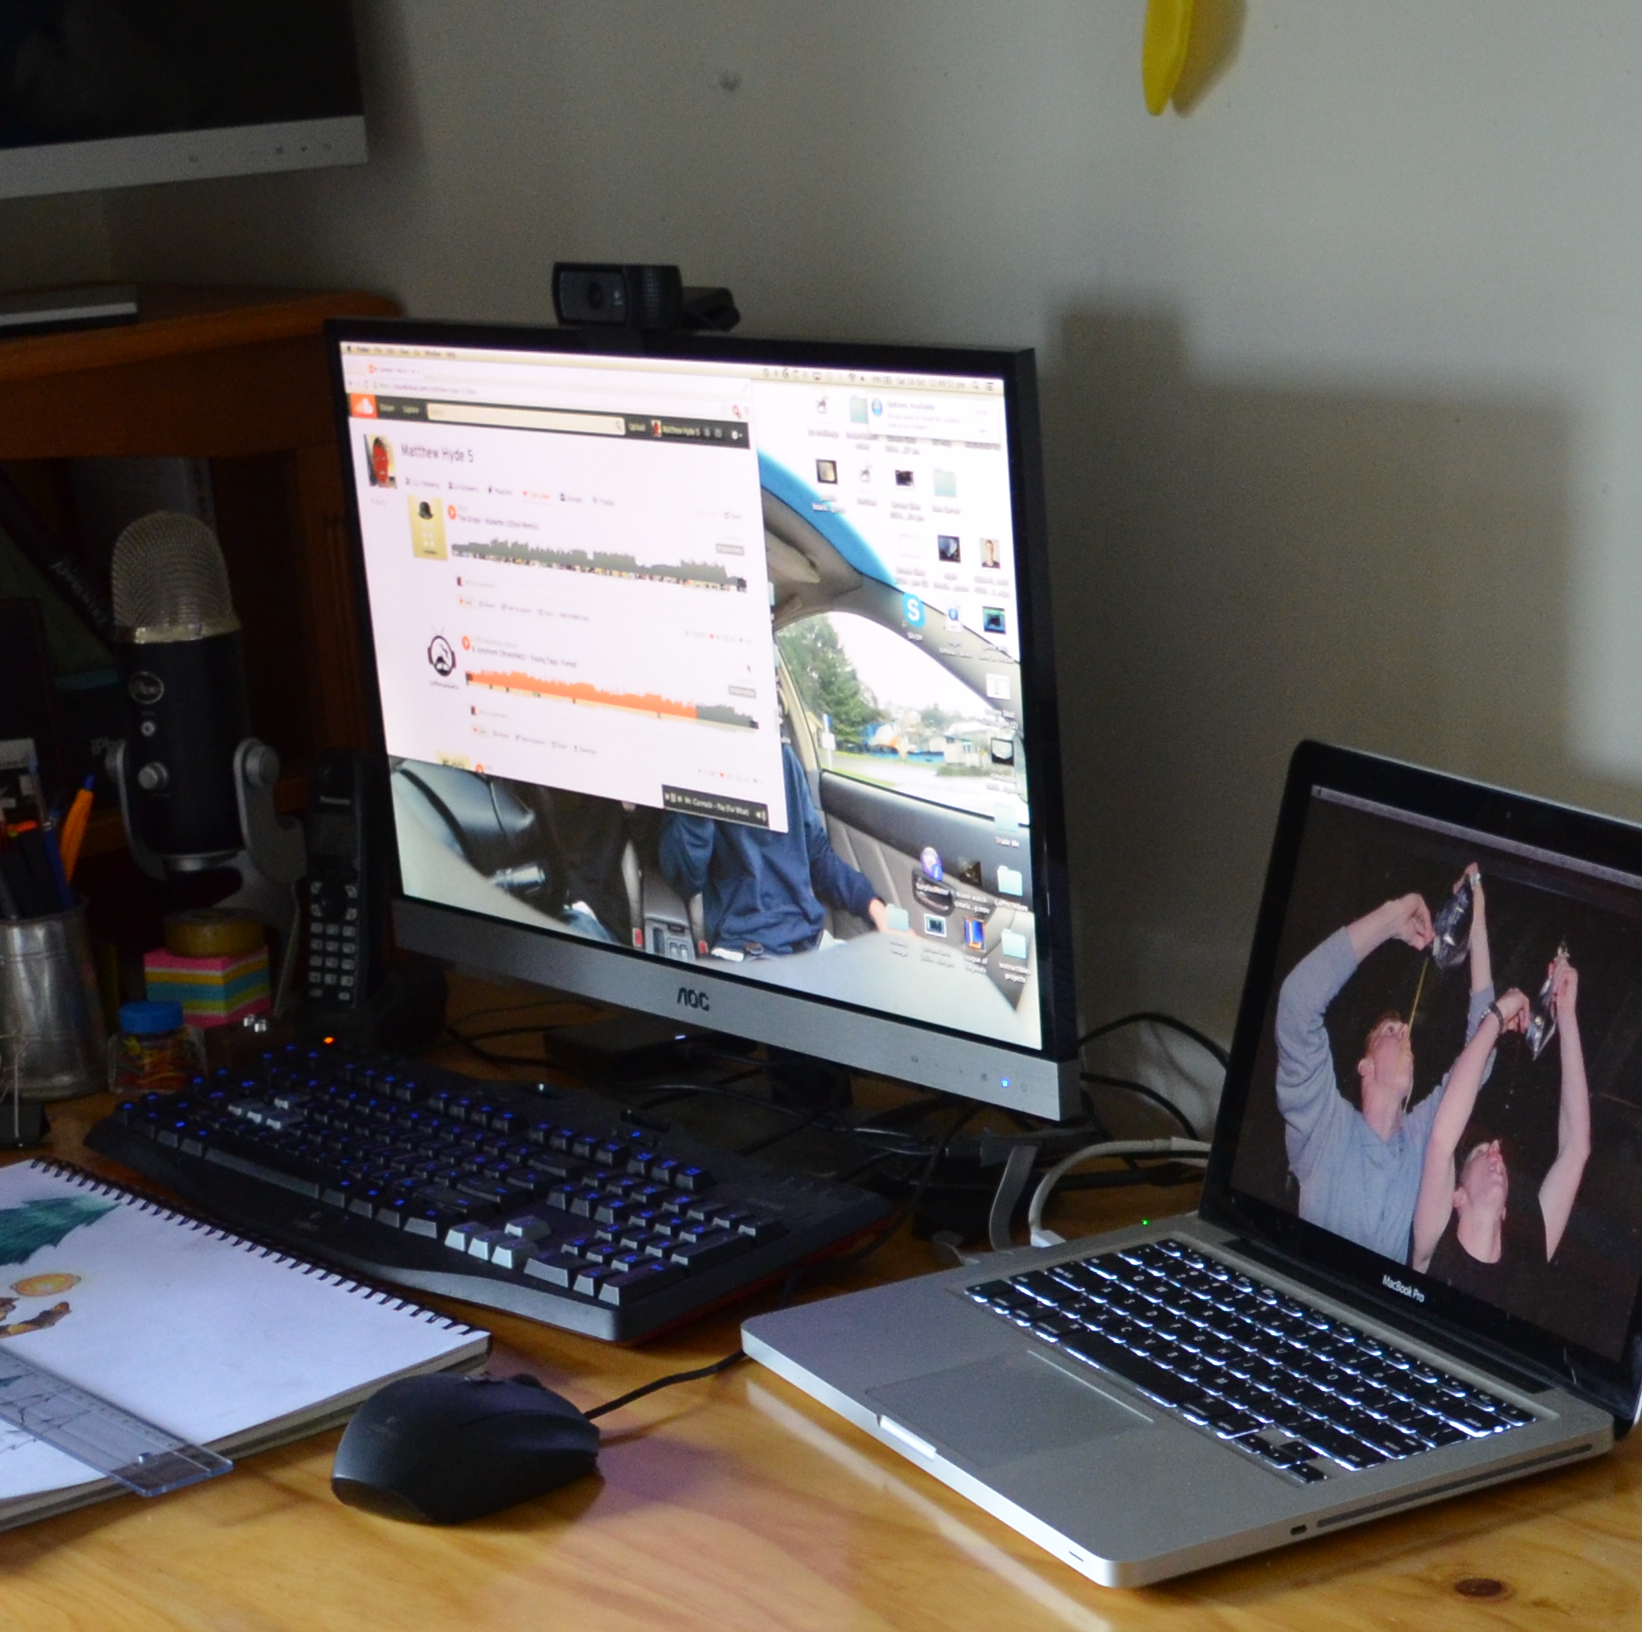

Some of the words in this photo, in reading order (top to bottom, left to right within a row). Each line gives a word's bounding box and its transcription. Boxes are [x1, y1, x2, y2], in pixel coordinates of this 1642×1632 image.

[401, 444, 439, 459] Matthew
[442, 446, 465, 463] Hyde
[1382, 1274, 1413, 1298] MacBook
[1413, 1288, 1425, 1303] Pro
